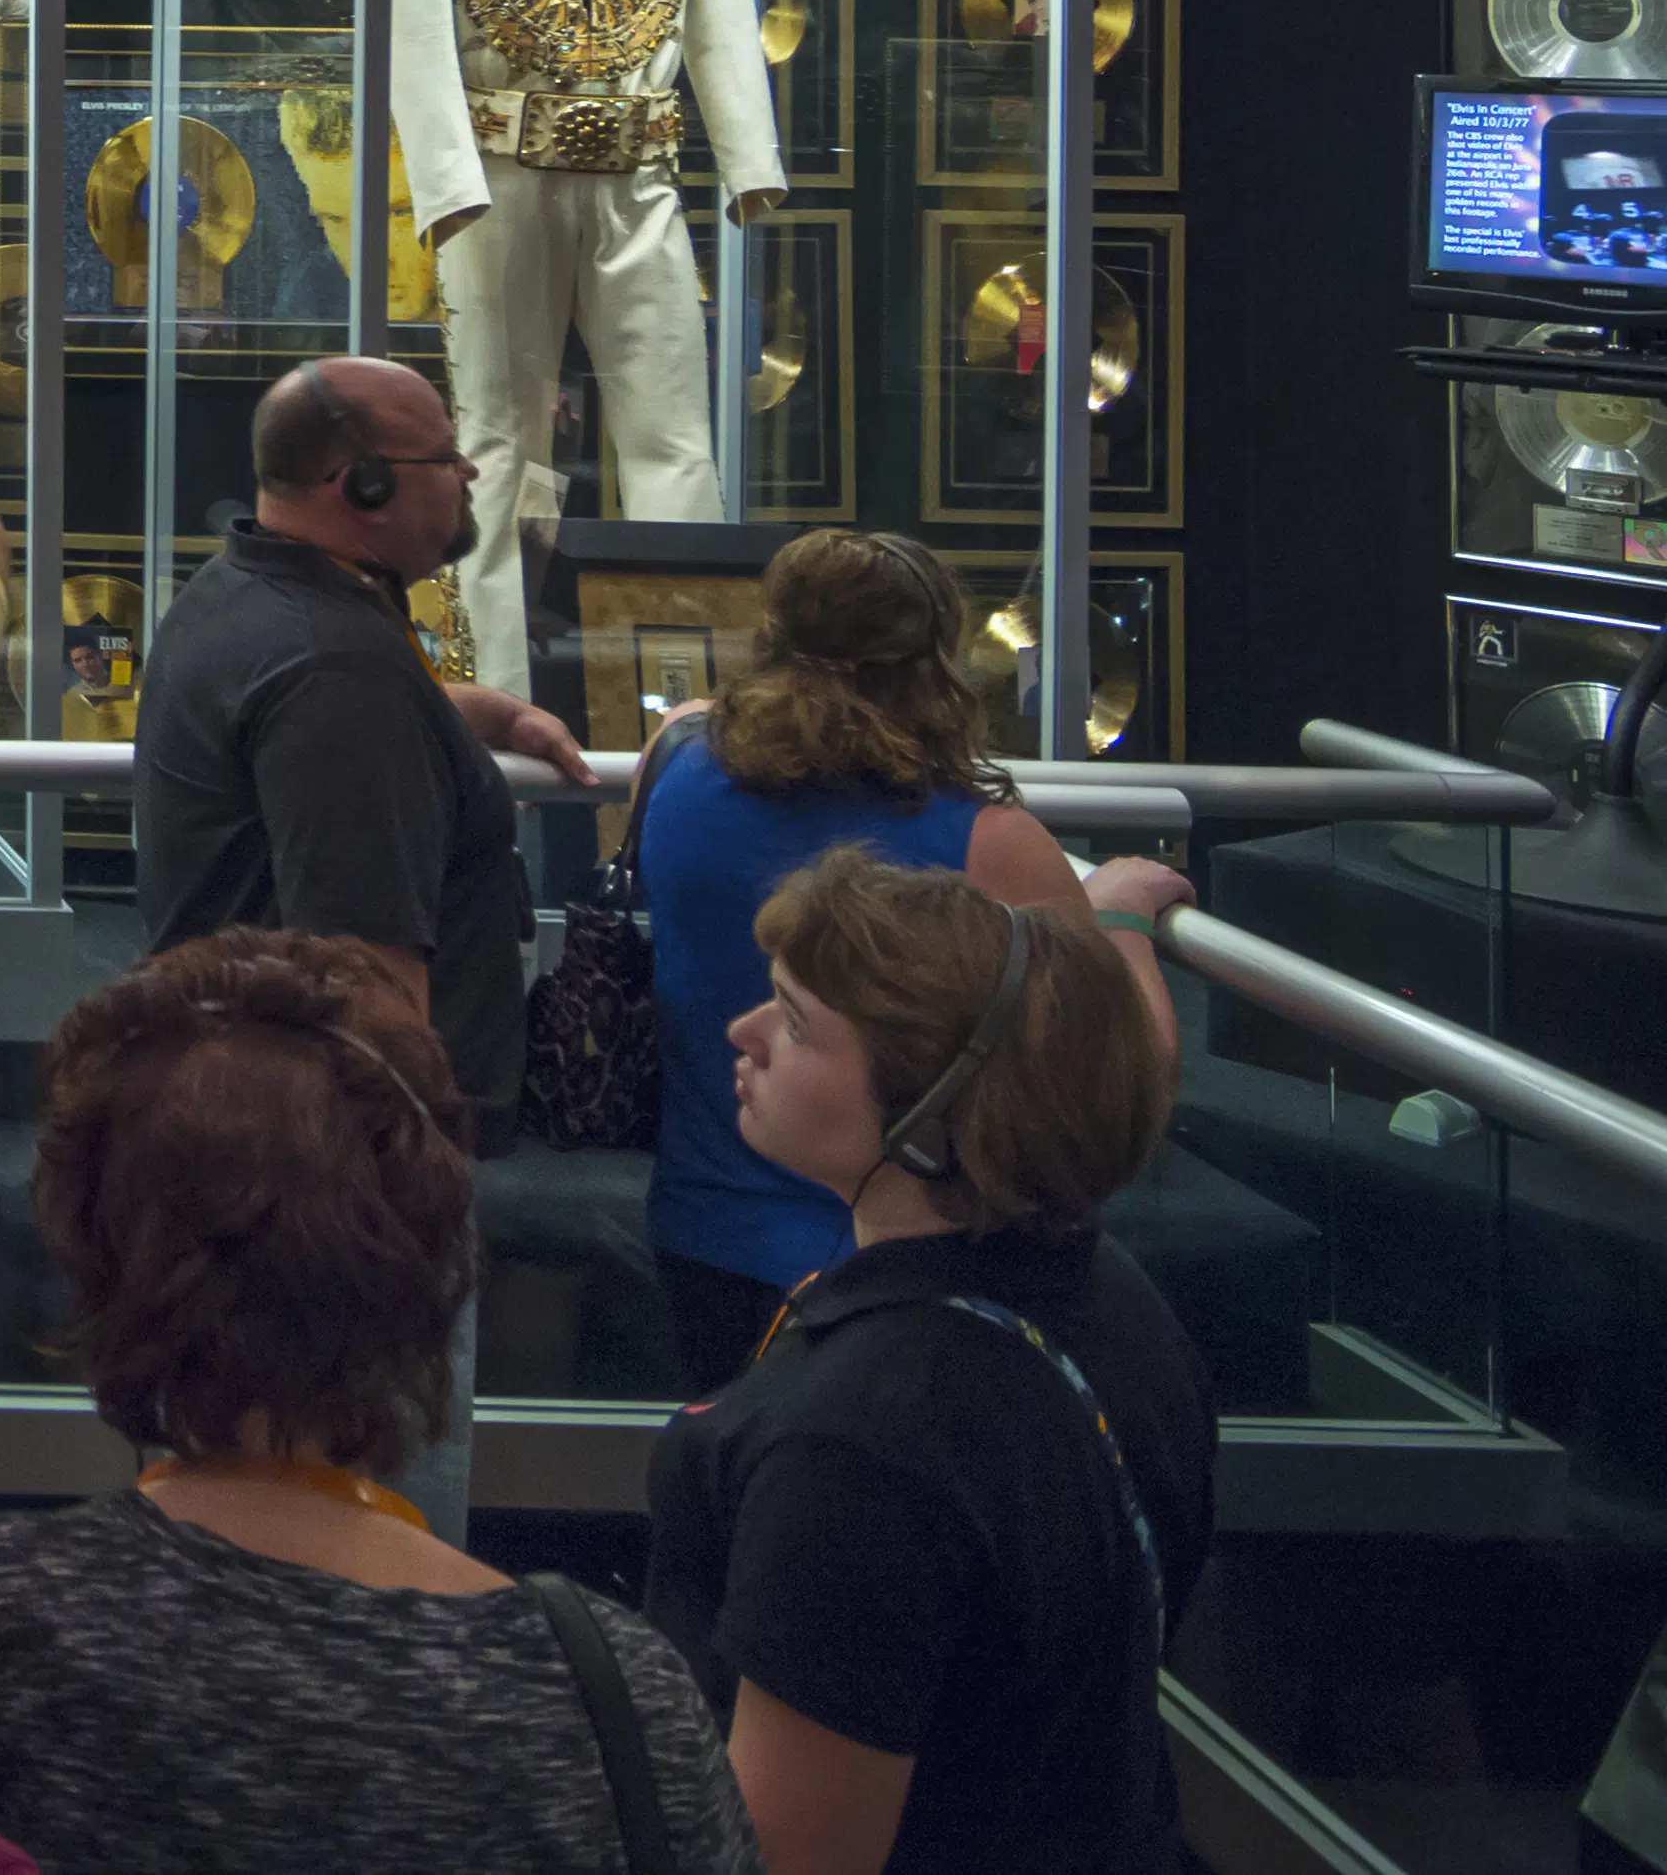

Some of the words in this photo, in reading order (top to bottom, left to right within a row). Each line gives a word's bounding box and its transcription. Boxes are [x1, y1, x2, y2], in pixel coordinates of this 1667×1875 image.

[81, 101, 104, 110] ELVIS
[106, 101, 144, 111] PRESLEY
[1447, 102, 1475, 114] "Elvis
[1477, 103, 1488, 114] In
[1490, 104, 1538, 116] Concert"
[1450, 115, 1479, 127] Aired
[1482, 117, 1529, 129] 10/3/77
[1447, 131, 1463, 140] The
[1465, 131, 1482, 141] CBS
[1483, 133, 1505, 141] crew
[1506, 133, 1524, 142] also
[1447, 140, 1465, 149] shot
[1467, 141, 1491, 150] video
[1492, 141, 1503, 150] of
[1446, 150, 1455, 159] at
[1457, 150, 1471, 159] the
[1473, 151, 1502, 161] airport
[1503, 152, 1513, 160] in
[1446, 159, 1498, 170] Indianapolis
[1498, 162, 1512, 170] on
[1471, 169, 1483, 178] An
[1484, 170, 1503, 179] RCA
[1505, 172, 1520, 182] rep
[1445, 178, 1489, 189] presented
[1489, 180, 1509, 189] Elvis
[1463, 188, 1473, 197] of
[1474, 189, 1487, 197] his
[1489, 191, 1515, 200] many
[1445, 198, 1475, 208] golden
[1476, 199, 1509, 208] records
[1444, 207, 1461, 215] this
[1462, 208, 1498, 219] footage.
[1444, 225, 1461, 235] The
[1462, 226, 1492, 237] special
[1493, 228, 1502, 237] is
[1461, 236, 1521, 249] professionally
[1443, 244, 1482, 255] recorded
[1483, 247, 1542, 258] performance.
[1582, 287, 1628, 298] SAMSUNG
[99, 636, 129, 650] ELVIS
